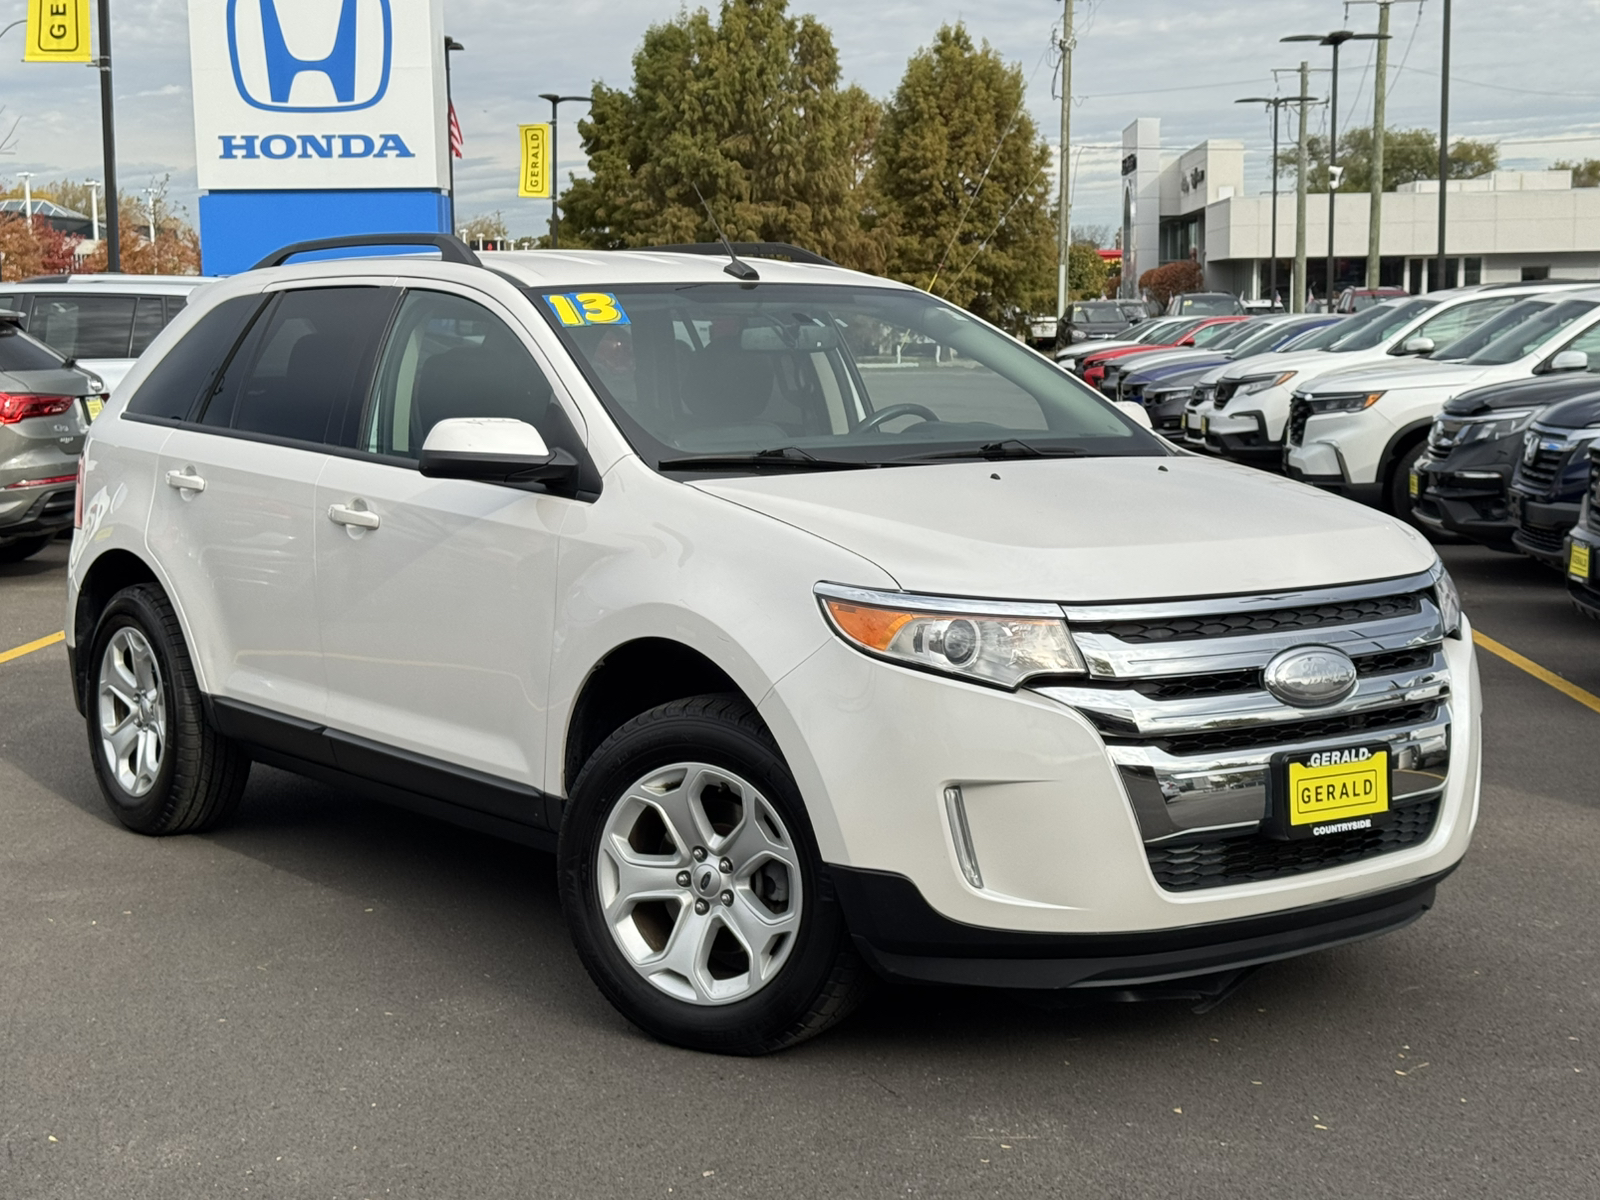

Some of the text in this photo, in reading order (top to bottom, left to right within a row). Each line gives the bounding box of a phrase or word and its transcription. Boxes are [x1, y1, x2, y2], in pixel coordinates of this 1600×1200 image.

[218, 134, 416, 160] HONDA
[530, 133, 540, 188] GERALD
[549, 292, 623, 326] 13
[1301, 779, 1373, 805] GERALD
[1312, 819, 1372, 837] COUNTRYSIDE
